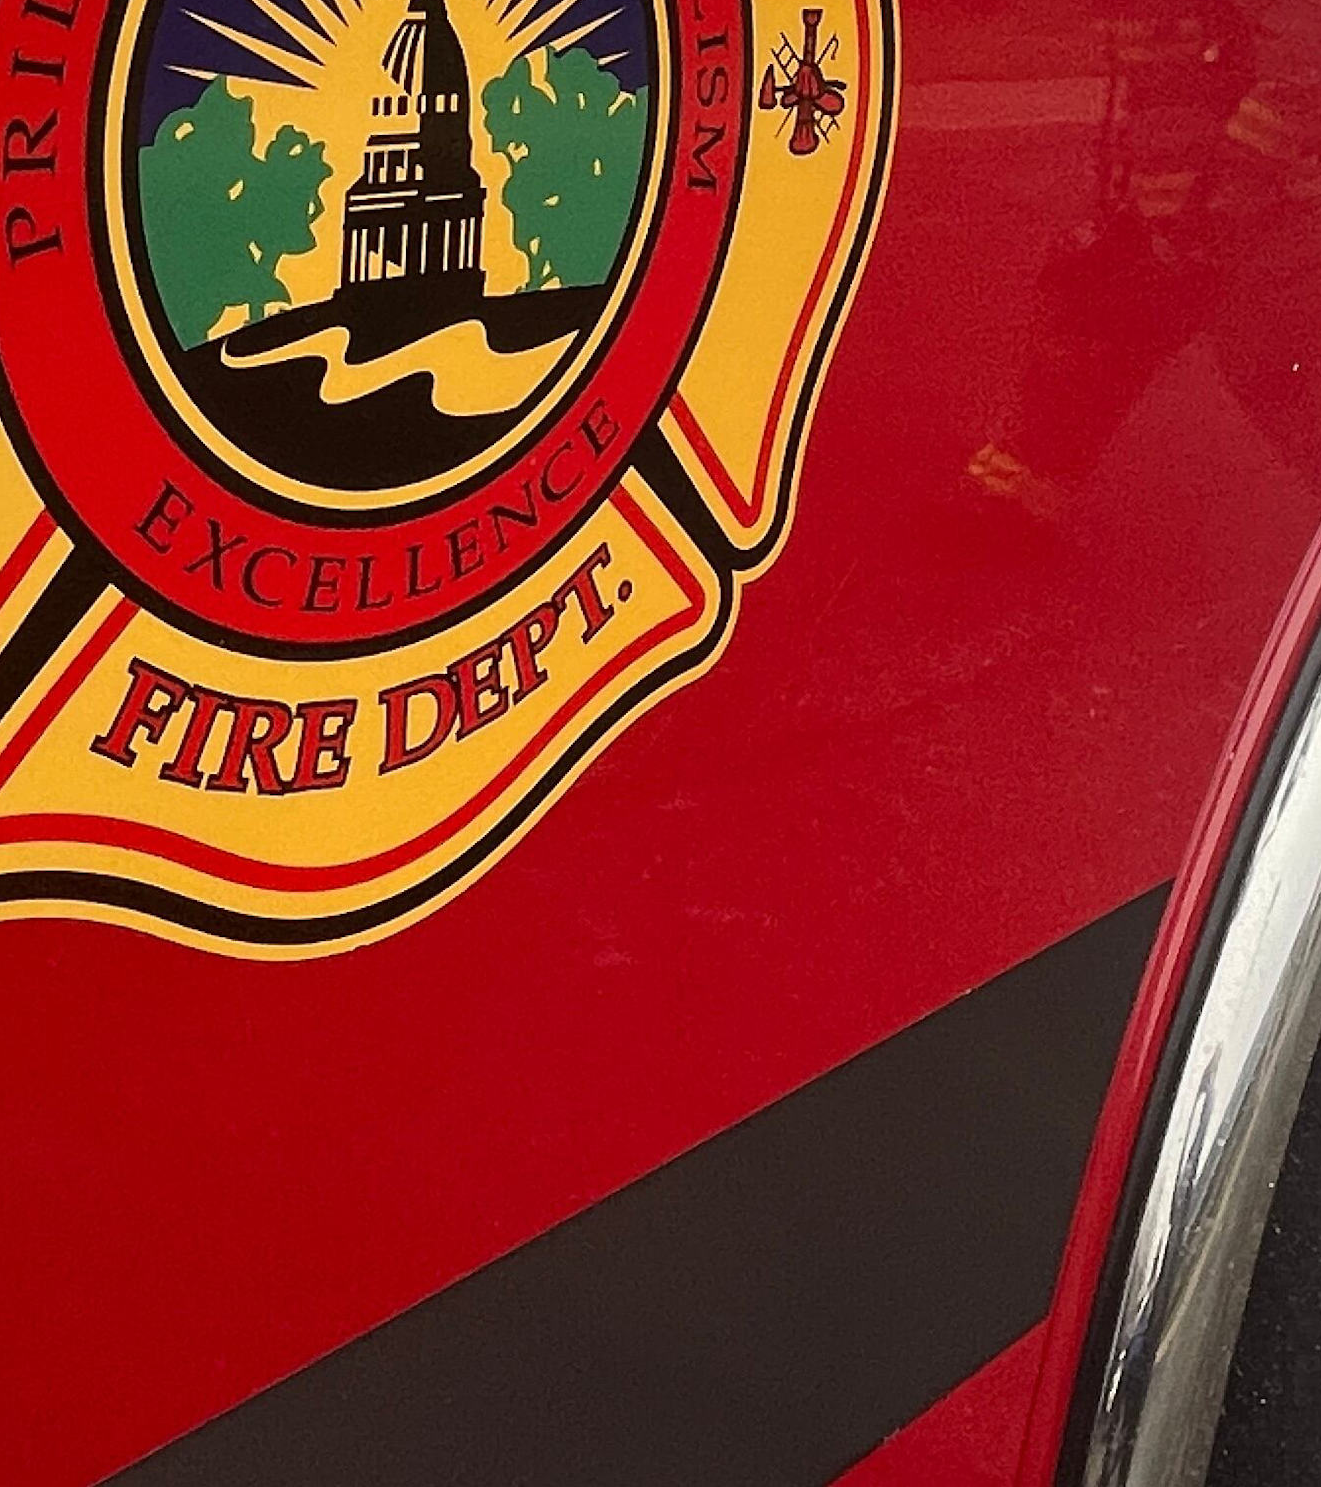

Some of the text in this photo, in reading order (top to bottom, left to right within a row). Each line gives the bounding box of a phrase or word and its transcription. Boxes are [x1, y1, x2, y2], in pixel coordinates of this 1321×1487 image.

[135, 400, 621, 613] EXCELLENCE
[90, 543, 634, 796] FIRE DEPT.
